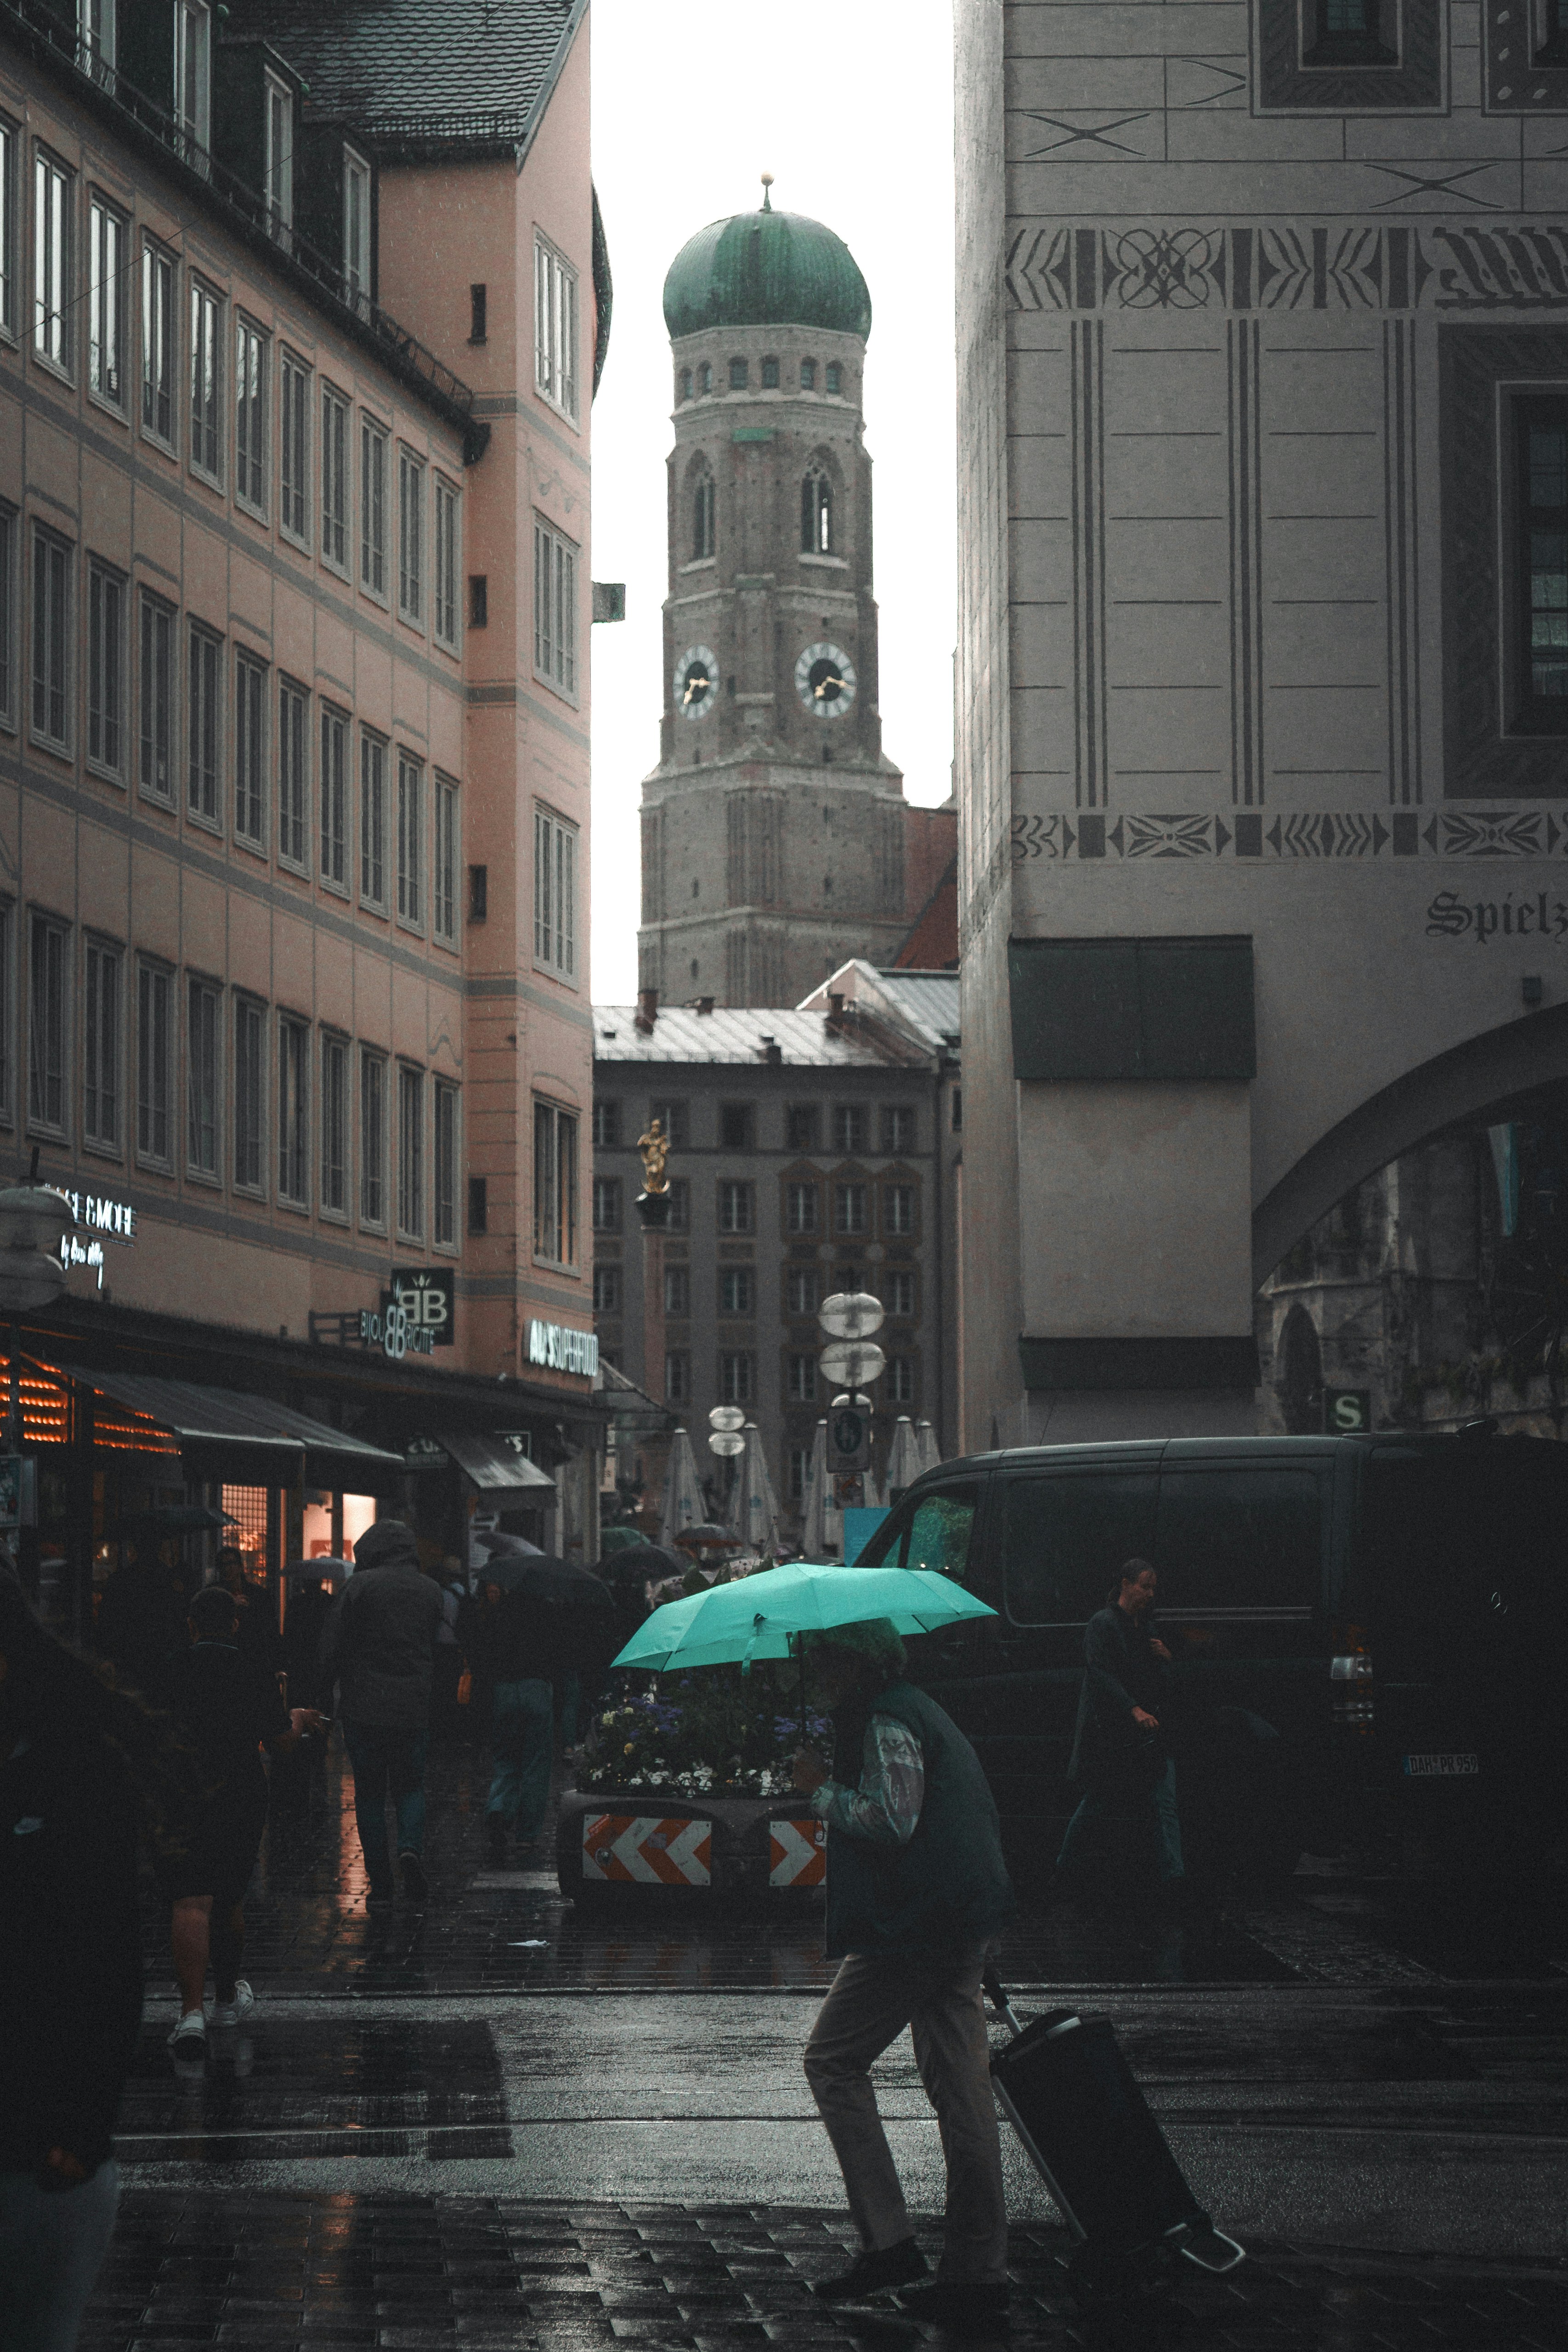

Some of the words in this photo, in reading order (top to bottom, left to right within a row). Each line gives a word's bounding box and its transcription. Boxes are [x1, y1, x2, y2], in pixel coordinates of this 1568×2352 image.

[1426, 892, 1568, 944] Spielz
[96, 1198, 137, 1238] MORE
[1336, 1396, 1361, 1429] S
[1410, 1757, 1433, 1774] DAH
[1440, 1756, 1455, 1773] PR
[1456, 1755, 1477, 1772] 959
